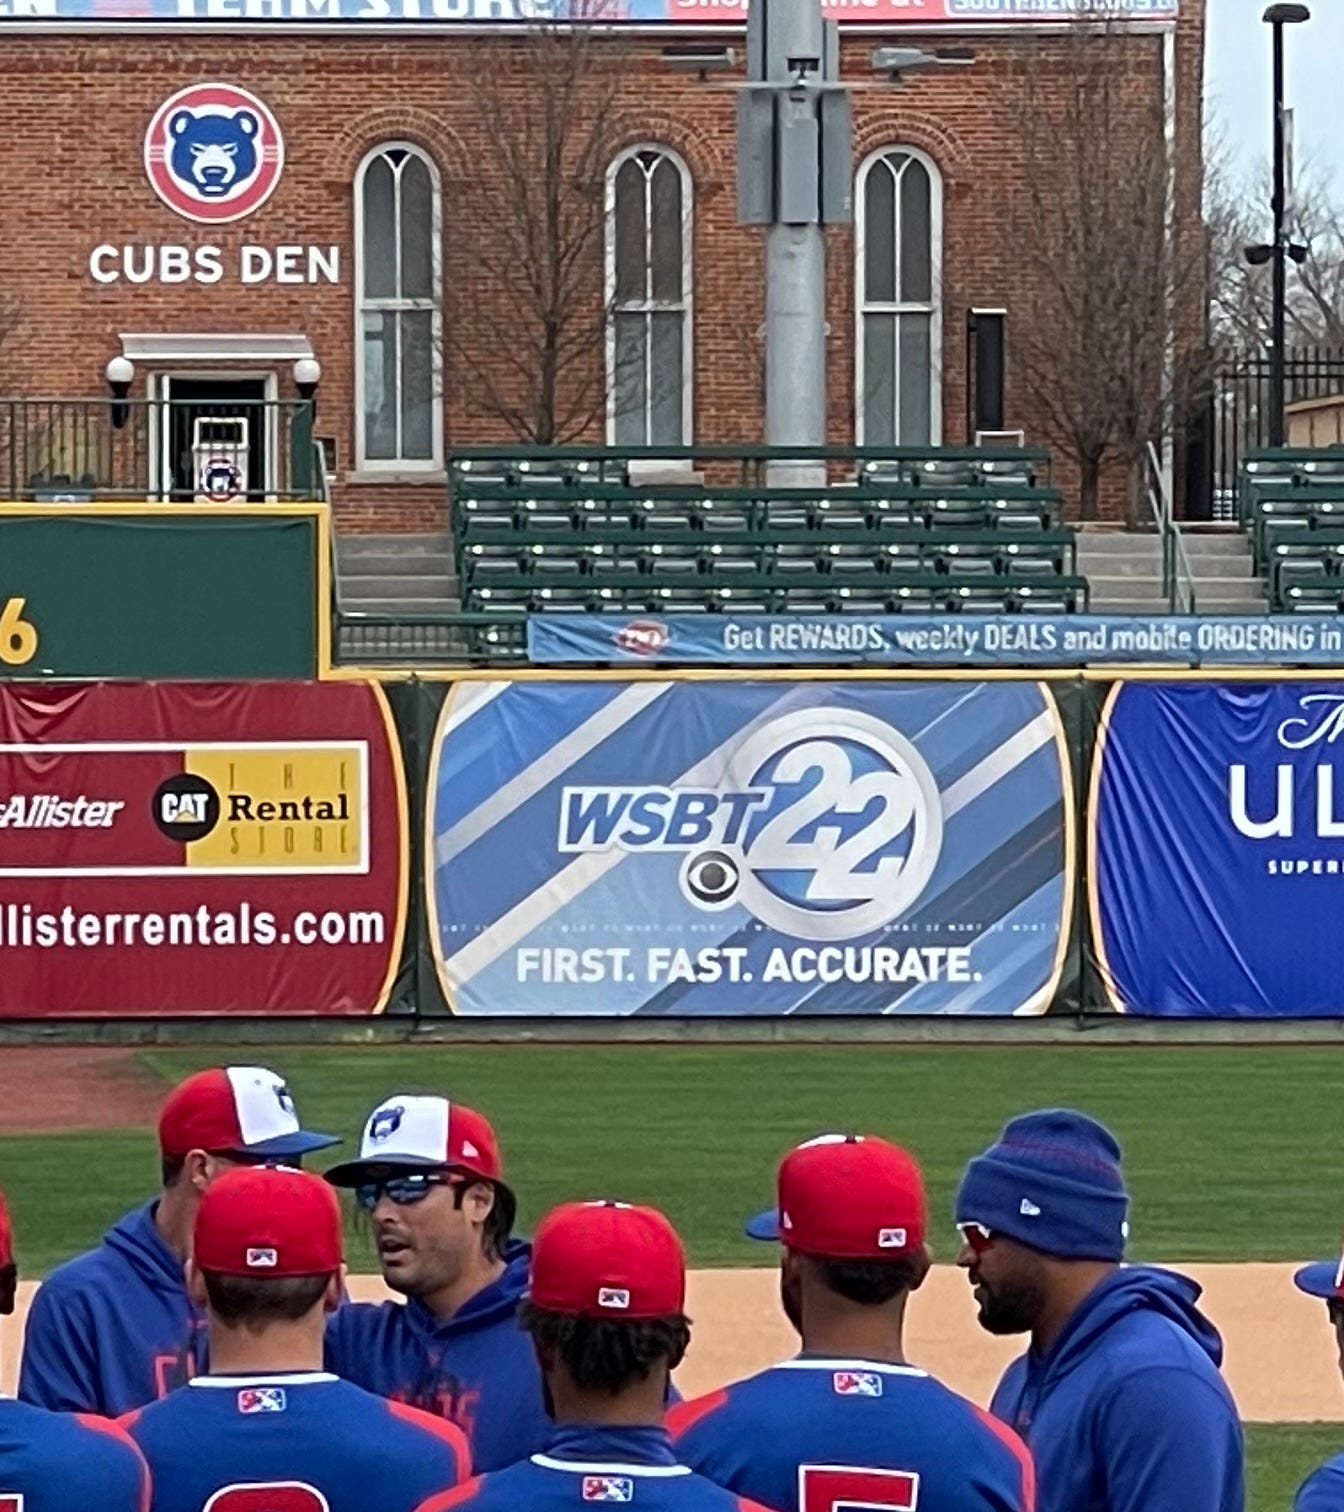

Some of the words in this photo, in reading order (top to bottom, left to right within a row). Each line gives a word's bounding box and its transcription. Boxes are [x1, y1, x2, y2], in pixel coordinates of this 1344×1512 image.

[90, 245, 223, 283] CUBS
[241, 245, 339, 283] DEN
[724, 623, 763, 651] Get
[770, 624, 890, 653] REWARDS,
[896, 624, 978, 656] weekly
[985, 625, 1055, 651] DEALS
[1064, 625, 1106, 651] and
[1112, 625, 1191, 651] mobile
[1198, 625, 1314, 651] ORDERING
[1321, 625, 1341, 651] in
[161, 792, 209, 823] CAT
[227, 793, 350, 821] Rental
[565, 792, 768, 846] WSBT
[748, 740, 915, 900] 22
[517, 947, 635, 983] FIRST.
[648, 947, 753, 983] FAST.
[763, 947, 983, 983] ACCURATE.
